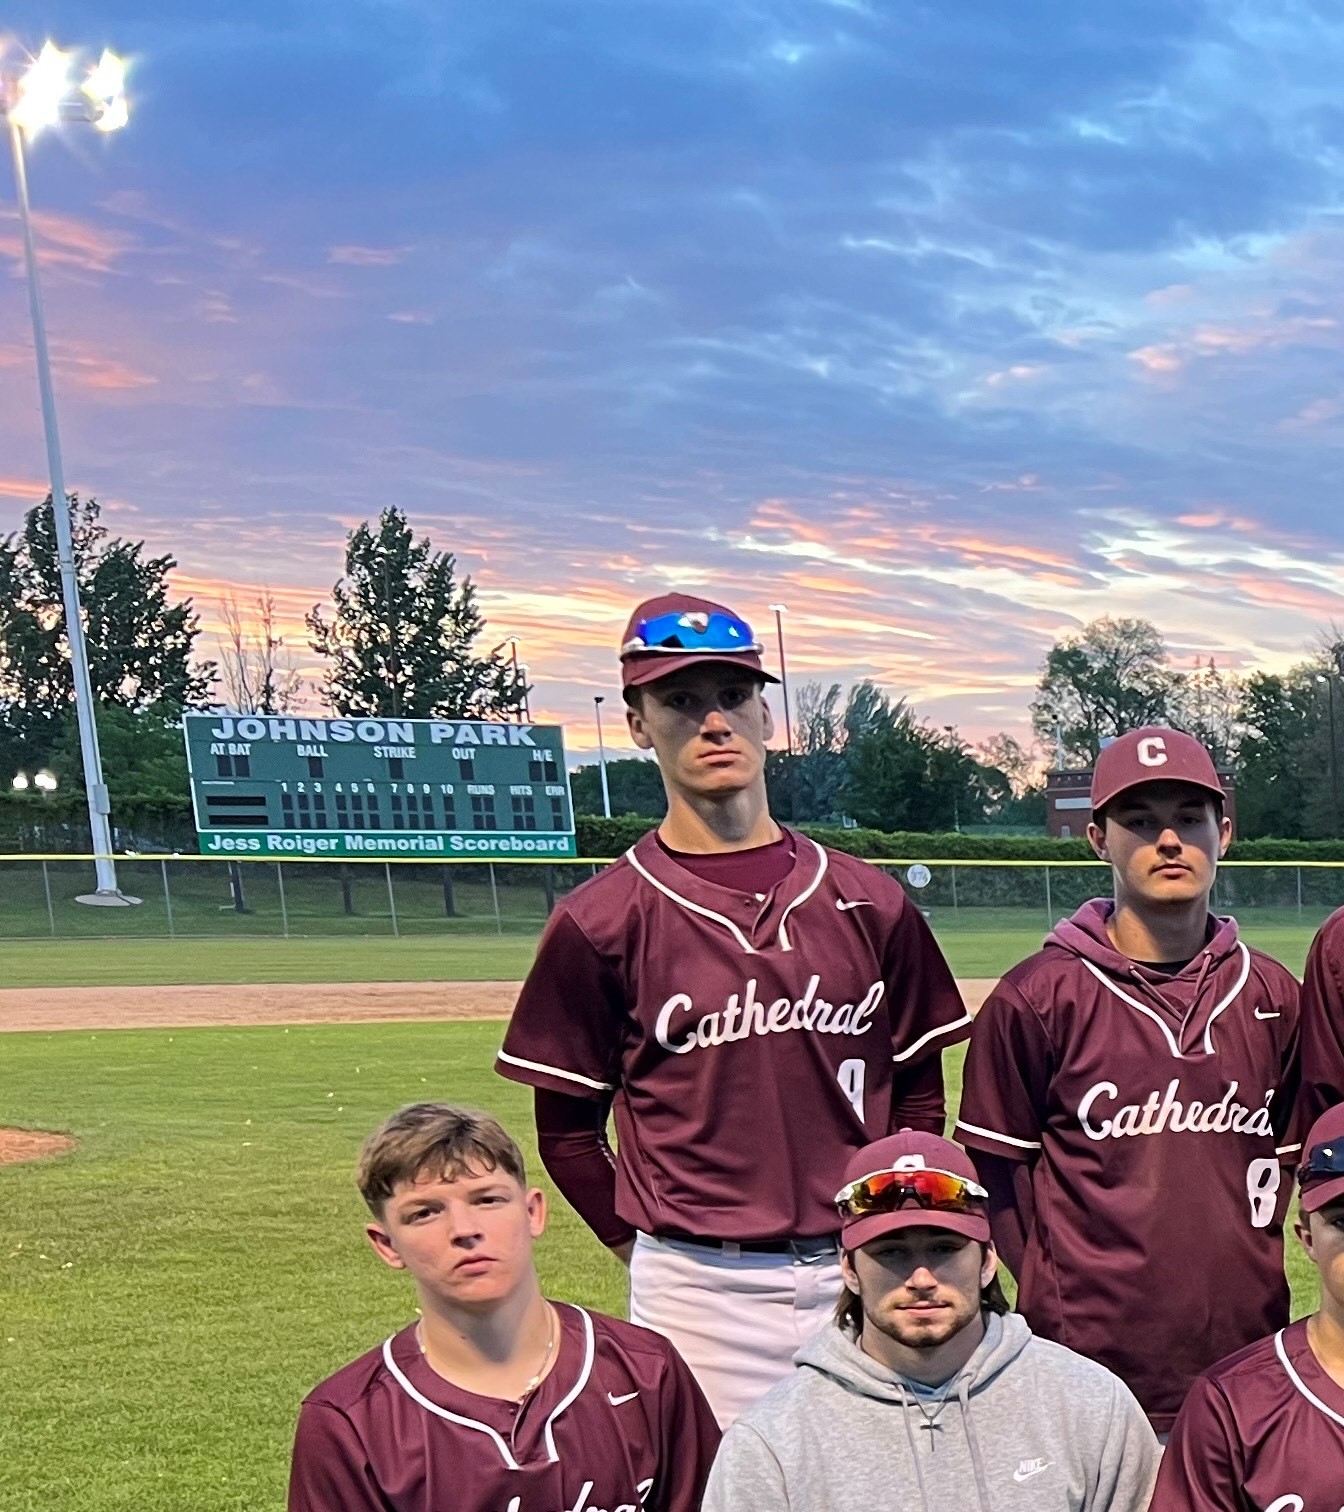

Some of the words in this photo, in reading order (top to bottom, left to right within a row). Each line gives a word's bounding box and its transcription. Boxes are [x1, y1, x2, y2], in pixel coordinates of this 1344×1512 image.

[211, 718, 415, 743] JOHNSON
[430, 723, 537, 747] PARK
[210, 743, 226, 755] AT
[228, 743, 251, 756] BAT
[296, 744, 329, 757] BALL
[373, 746, 417, 759] STRIKE
[452, 747, 476, 760] OUT
[1137, 736, 1168, 767] C
[281, 782, 288, 793] 1
[297, 782, 305, 793] 2
[313, 782, 322, 793] 3
[335, 783, 343, 793] 4
[351, 783, 359, 793] 5
[367, 783, 375, 793] 6
[390, 783, 398, 794] 7
[407, 783, 415, 794] 8
[423, 783, 431, 794] 9
[440, 784, 454, 795] 10
[467, 785, 495, 796] RUNS
[510, 785, 533, 796] HITS
[207, 834, 261, 851] Jess
[266, 834, 339, 854] Roiger
[344, 834, 445, 851] Memorial
[450, 835, 569, 851] Scoreboard
[655, 975, 885, 1054] Cathedral
[1246, 1158, 1281, 1228] 8
[1018, 1457, 1045, 1473] NIKE
